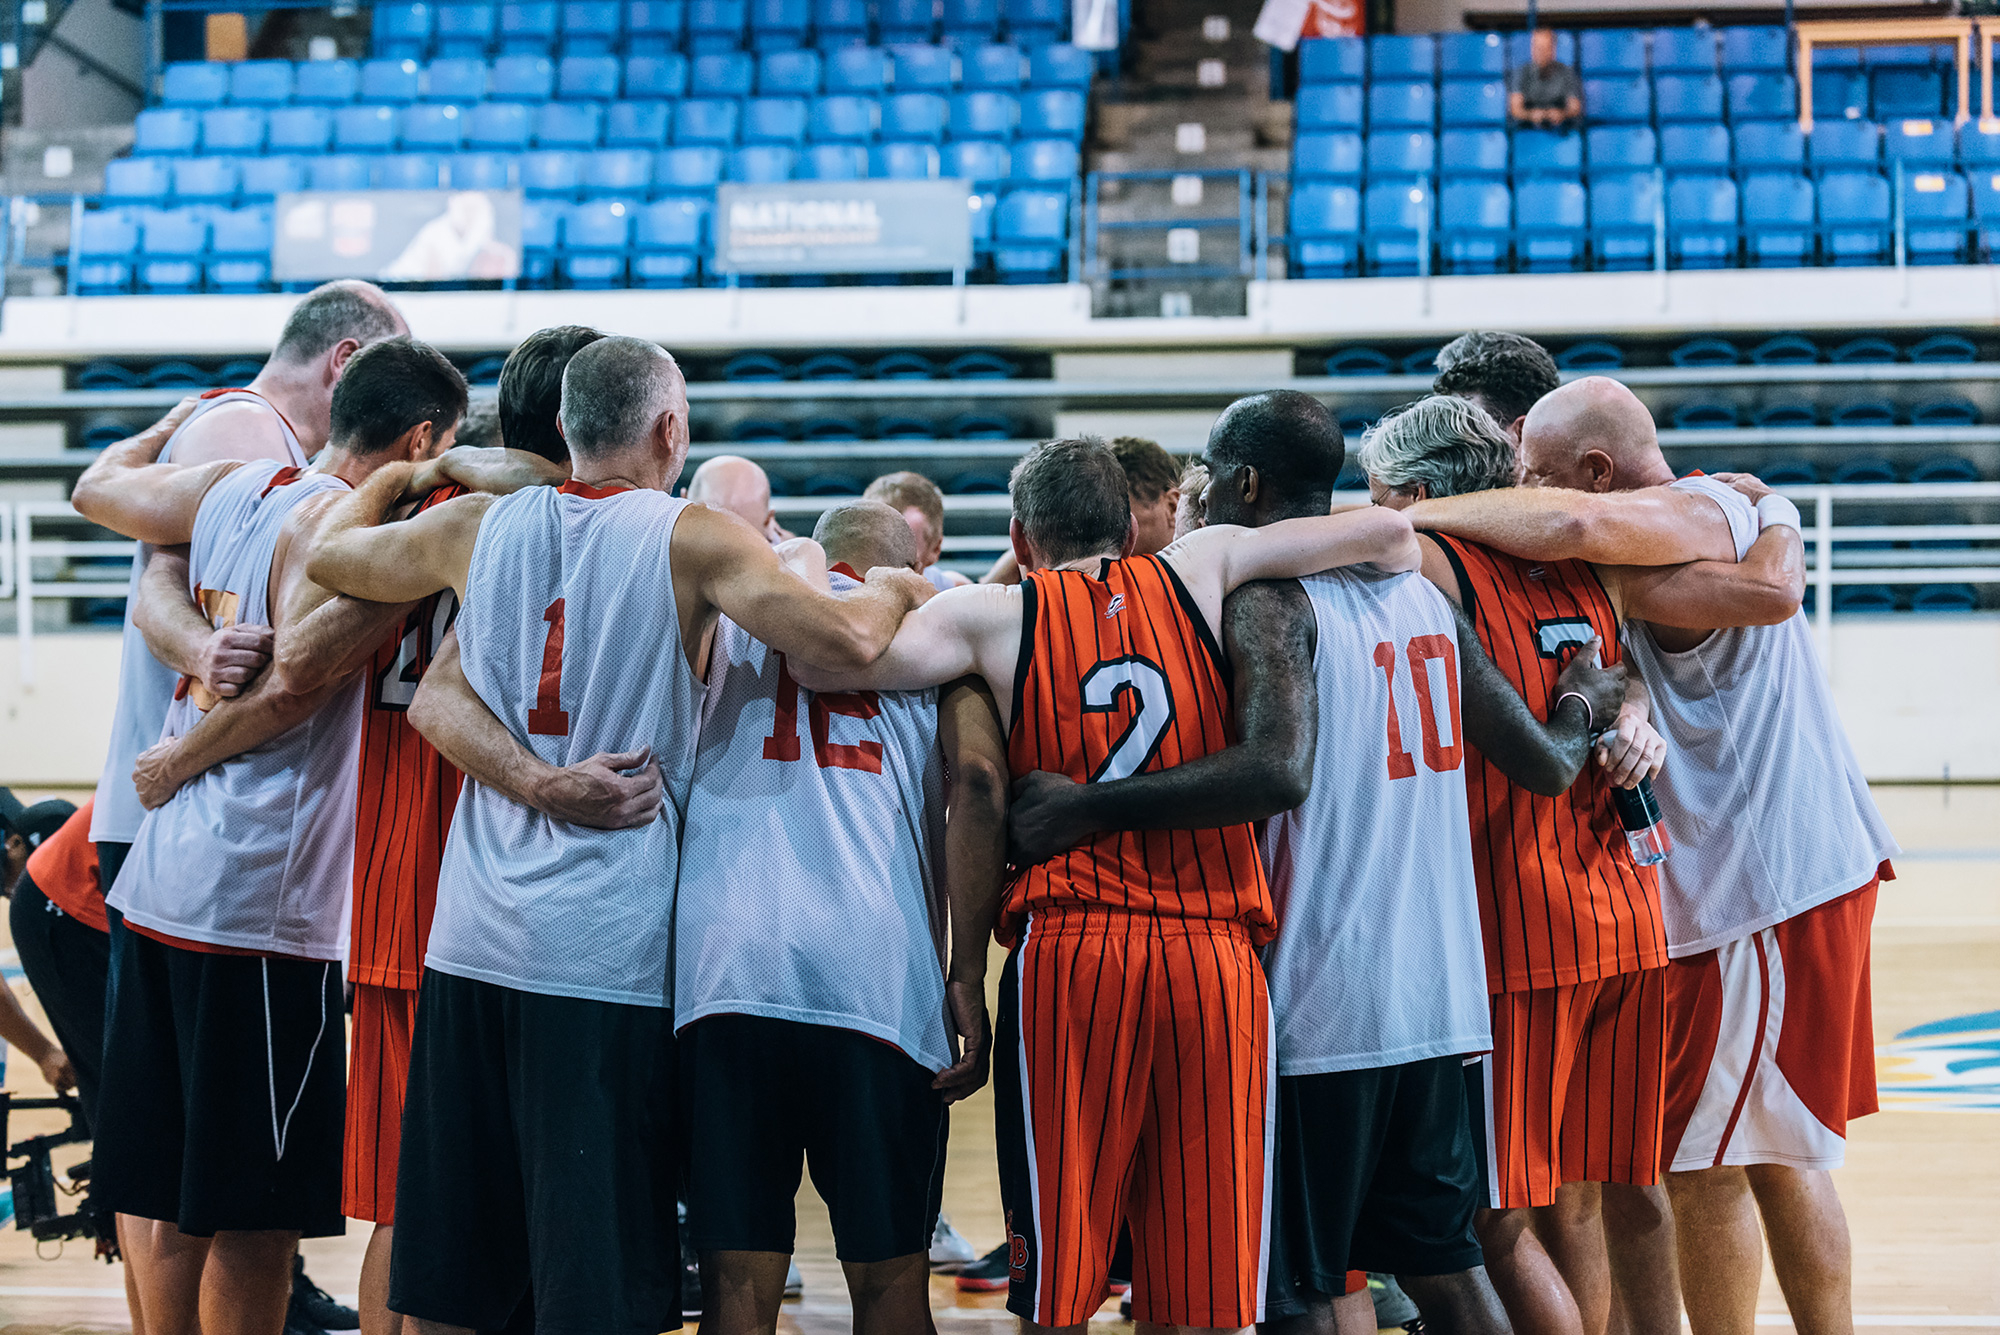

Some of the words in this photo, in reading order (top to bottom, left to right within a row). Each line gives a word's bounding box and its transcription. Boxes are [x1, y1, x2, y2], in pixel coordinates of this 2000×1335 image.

[730, 200, 882, 228] NATIONAL
[528, 598, 569, 736] 1
[1080, 654, 1175, 784] 2
[1373, 633, 1463, 781] 10
